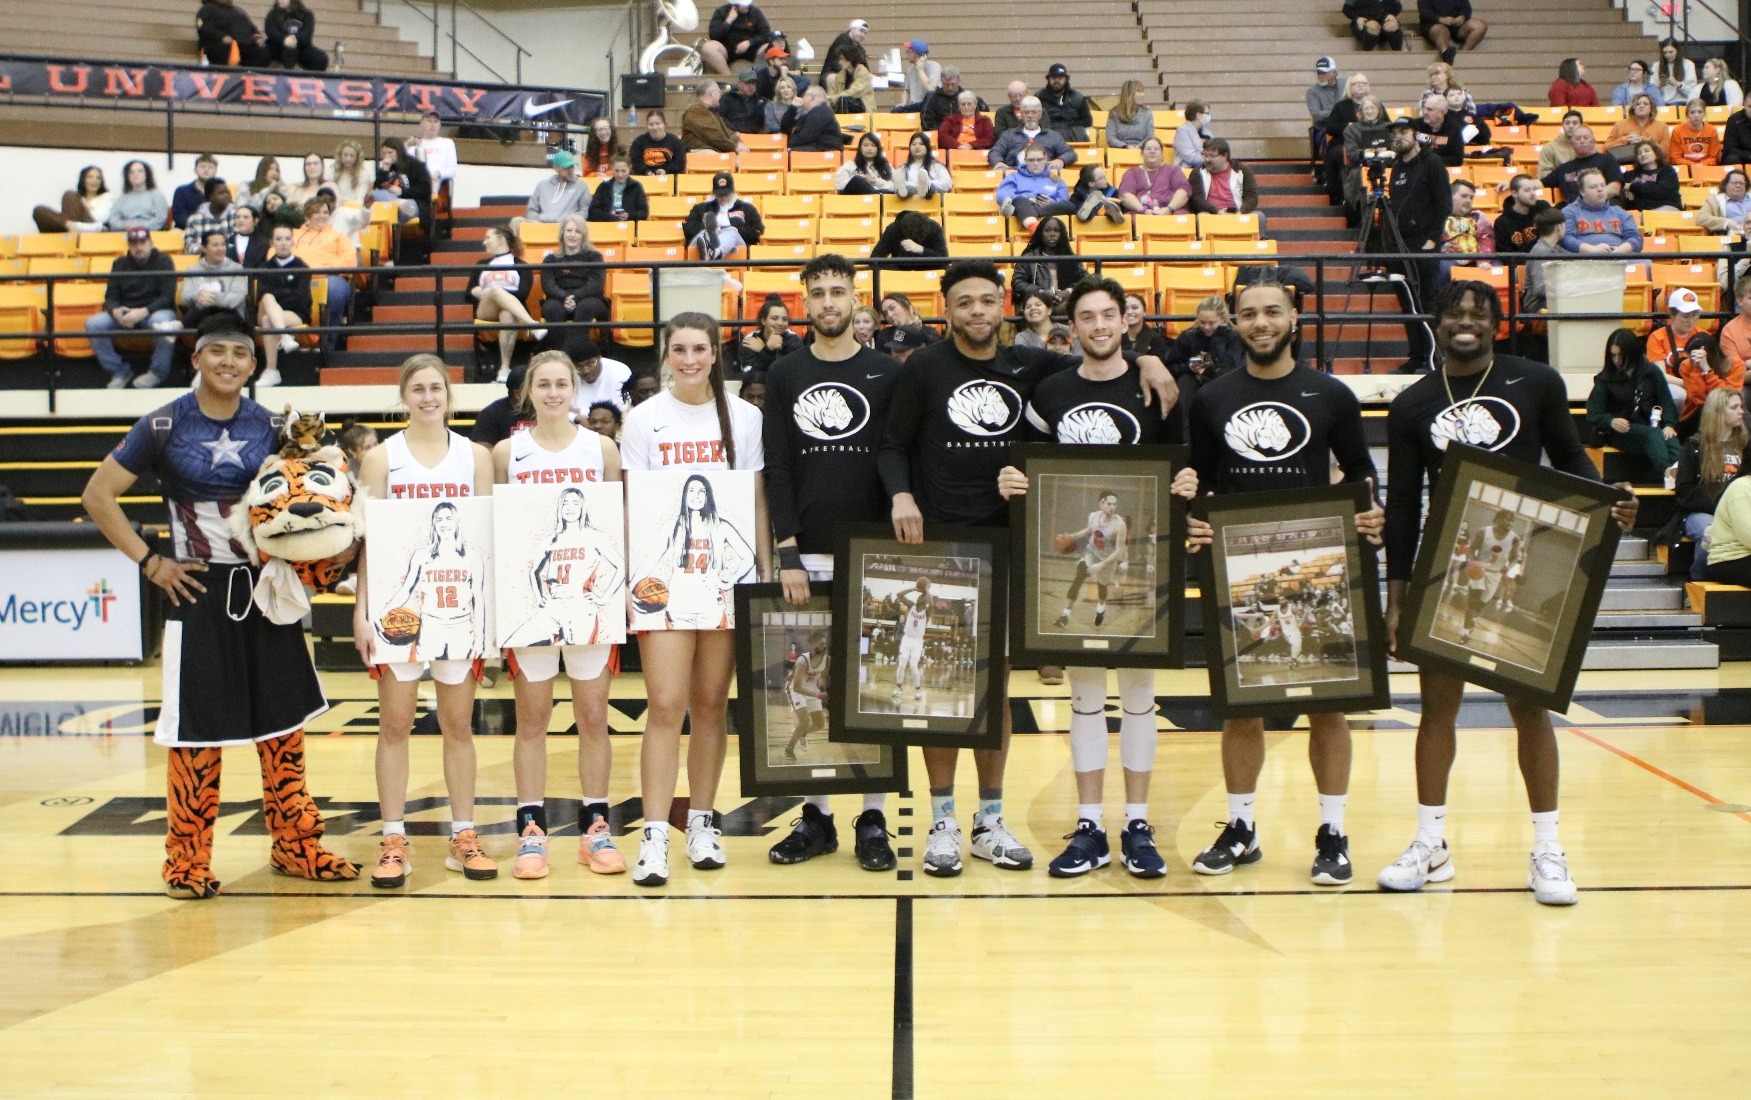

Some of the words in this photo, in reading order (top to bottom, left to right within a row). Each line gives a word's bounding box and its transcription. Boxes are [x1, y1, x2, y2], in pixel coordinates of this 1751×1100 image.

[46, 65, 487, 113] UNIVERSITY
[659, 440, 728, 466] TIGER
[947, 440, 1011, 448] BASKETB
[426, 569, 468, 583] TIGERS
[436, 586, 459, 608] 12
[0, 593, 88, 631] Mercy
